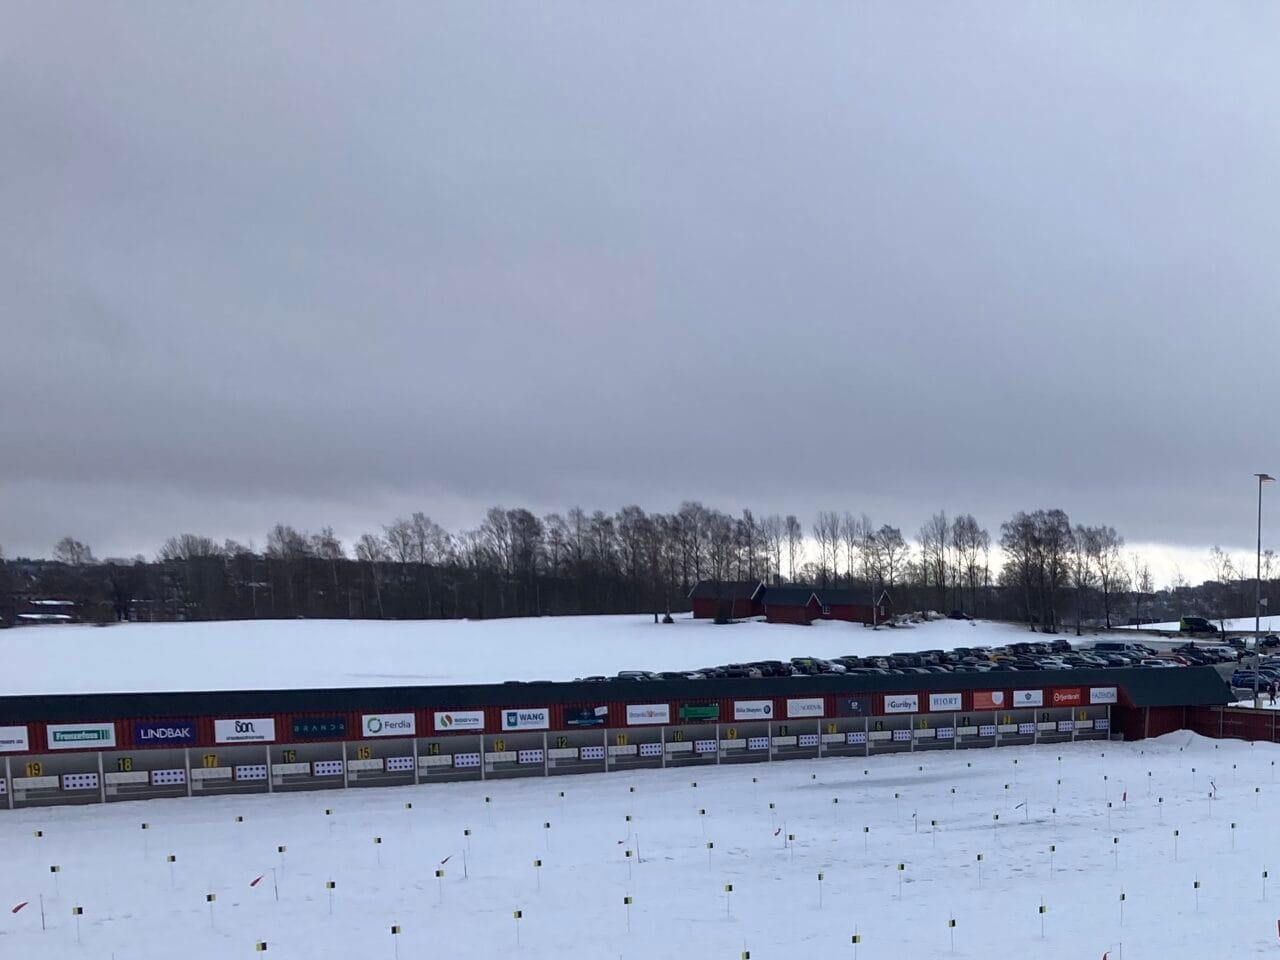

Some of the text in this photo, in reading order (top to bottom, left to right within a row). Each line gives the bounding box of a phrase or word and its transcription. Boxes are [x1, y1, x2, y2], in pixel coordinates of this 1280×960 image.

[519, 712, 545, 721] WANG
[385, 719, 411, 730] Ferdia
[141, 728, 190, 739] LINDBAK
[495, 740, 504, 751] 13
[558, 737, 567, 747] 12
[359, 747, 370, 758] 15
[429, 743, 439, 755] 14
[204, 755, 216, 767] 17
[284, 751, 296, 762] 16
[27, 763, 41, 776] 19
[118, 759, 131, 771] 18
